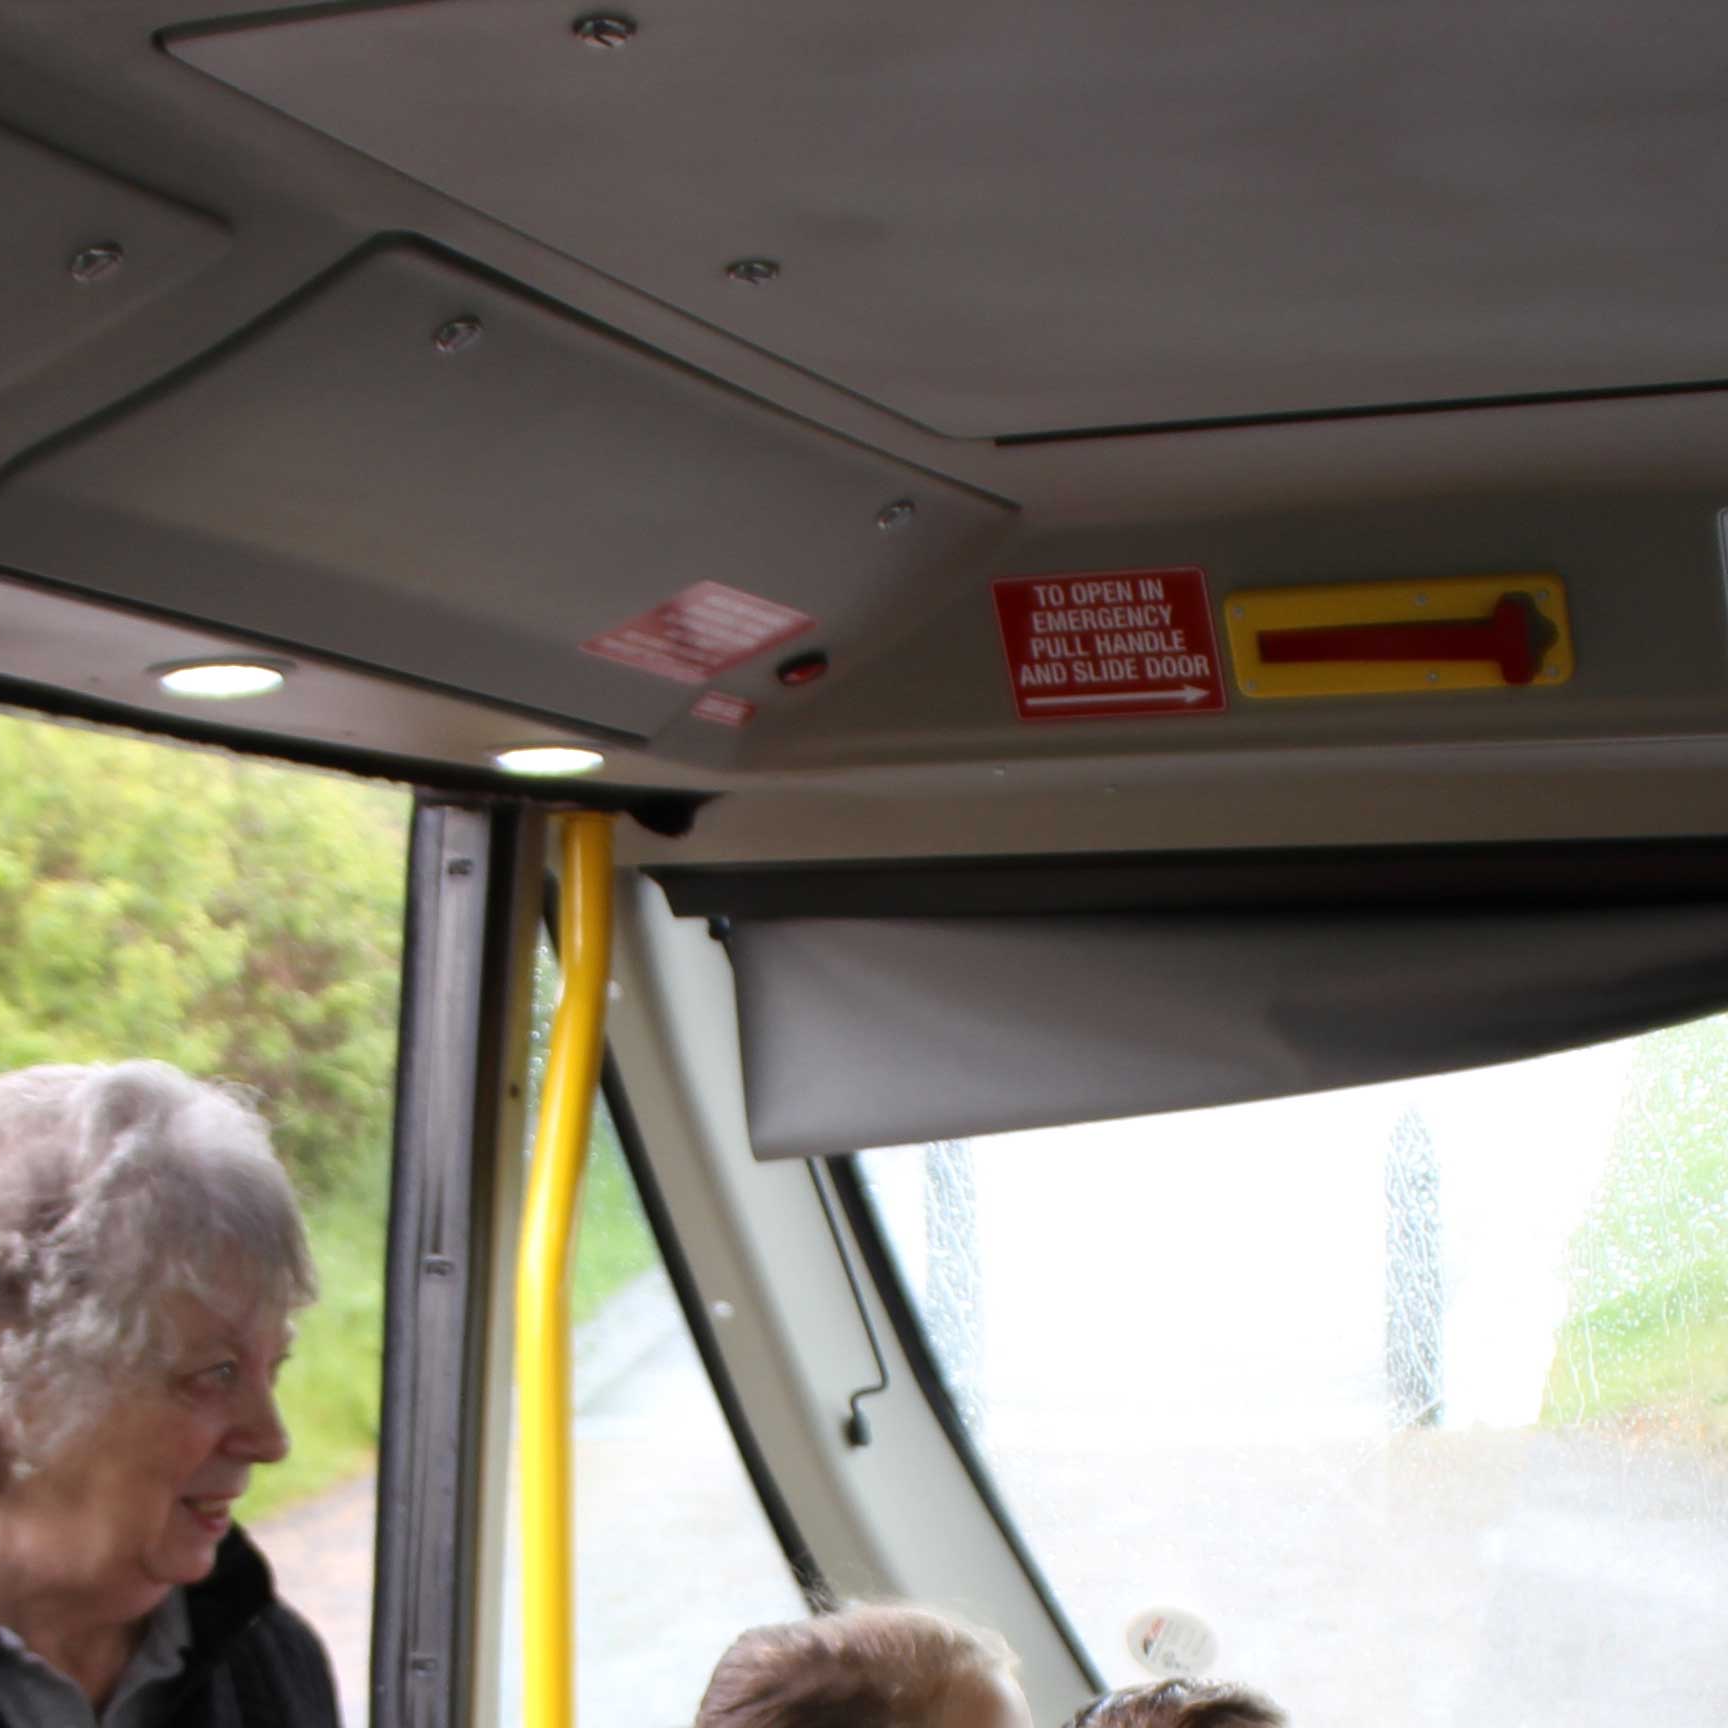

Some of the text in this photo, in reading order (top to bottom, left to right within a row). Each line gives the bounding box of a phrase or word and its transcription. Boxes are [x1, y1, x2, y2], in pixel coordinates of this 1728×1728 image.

[1032, 577, 1166, 608] TO OPEN IN
[1030, 603, 1173, 634] EMERGENCY
[1029, 628, 1188, 660] PULL HANDLE
[1019, 653, 1211, 687] AND SLIDE DOOR
